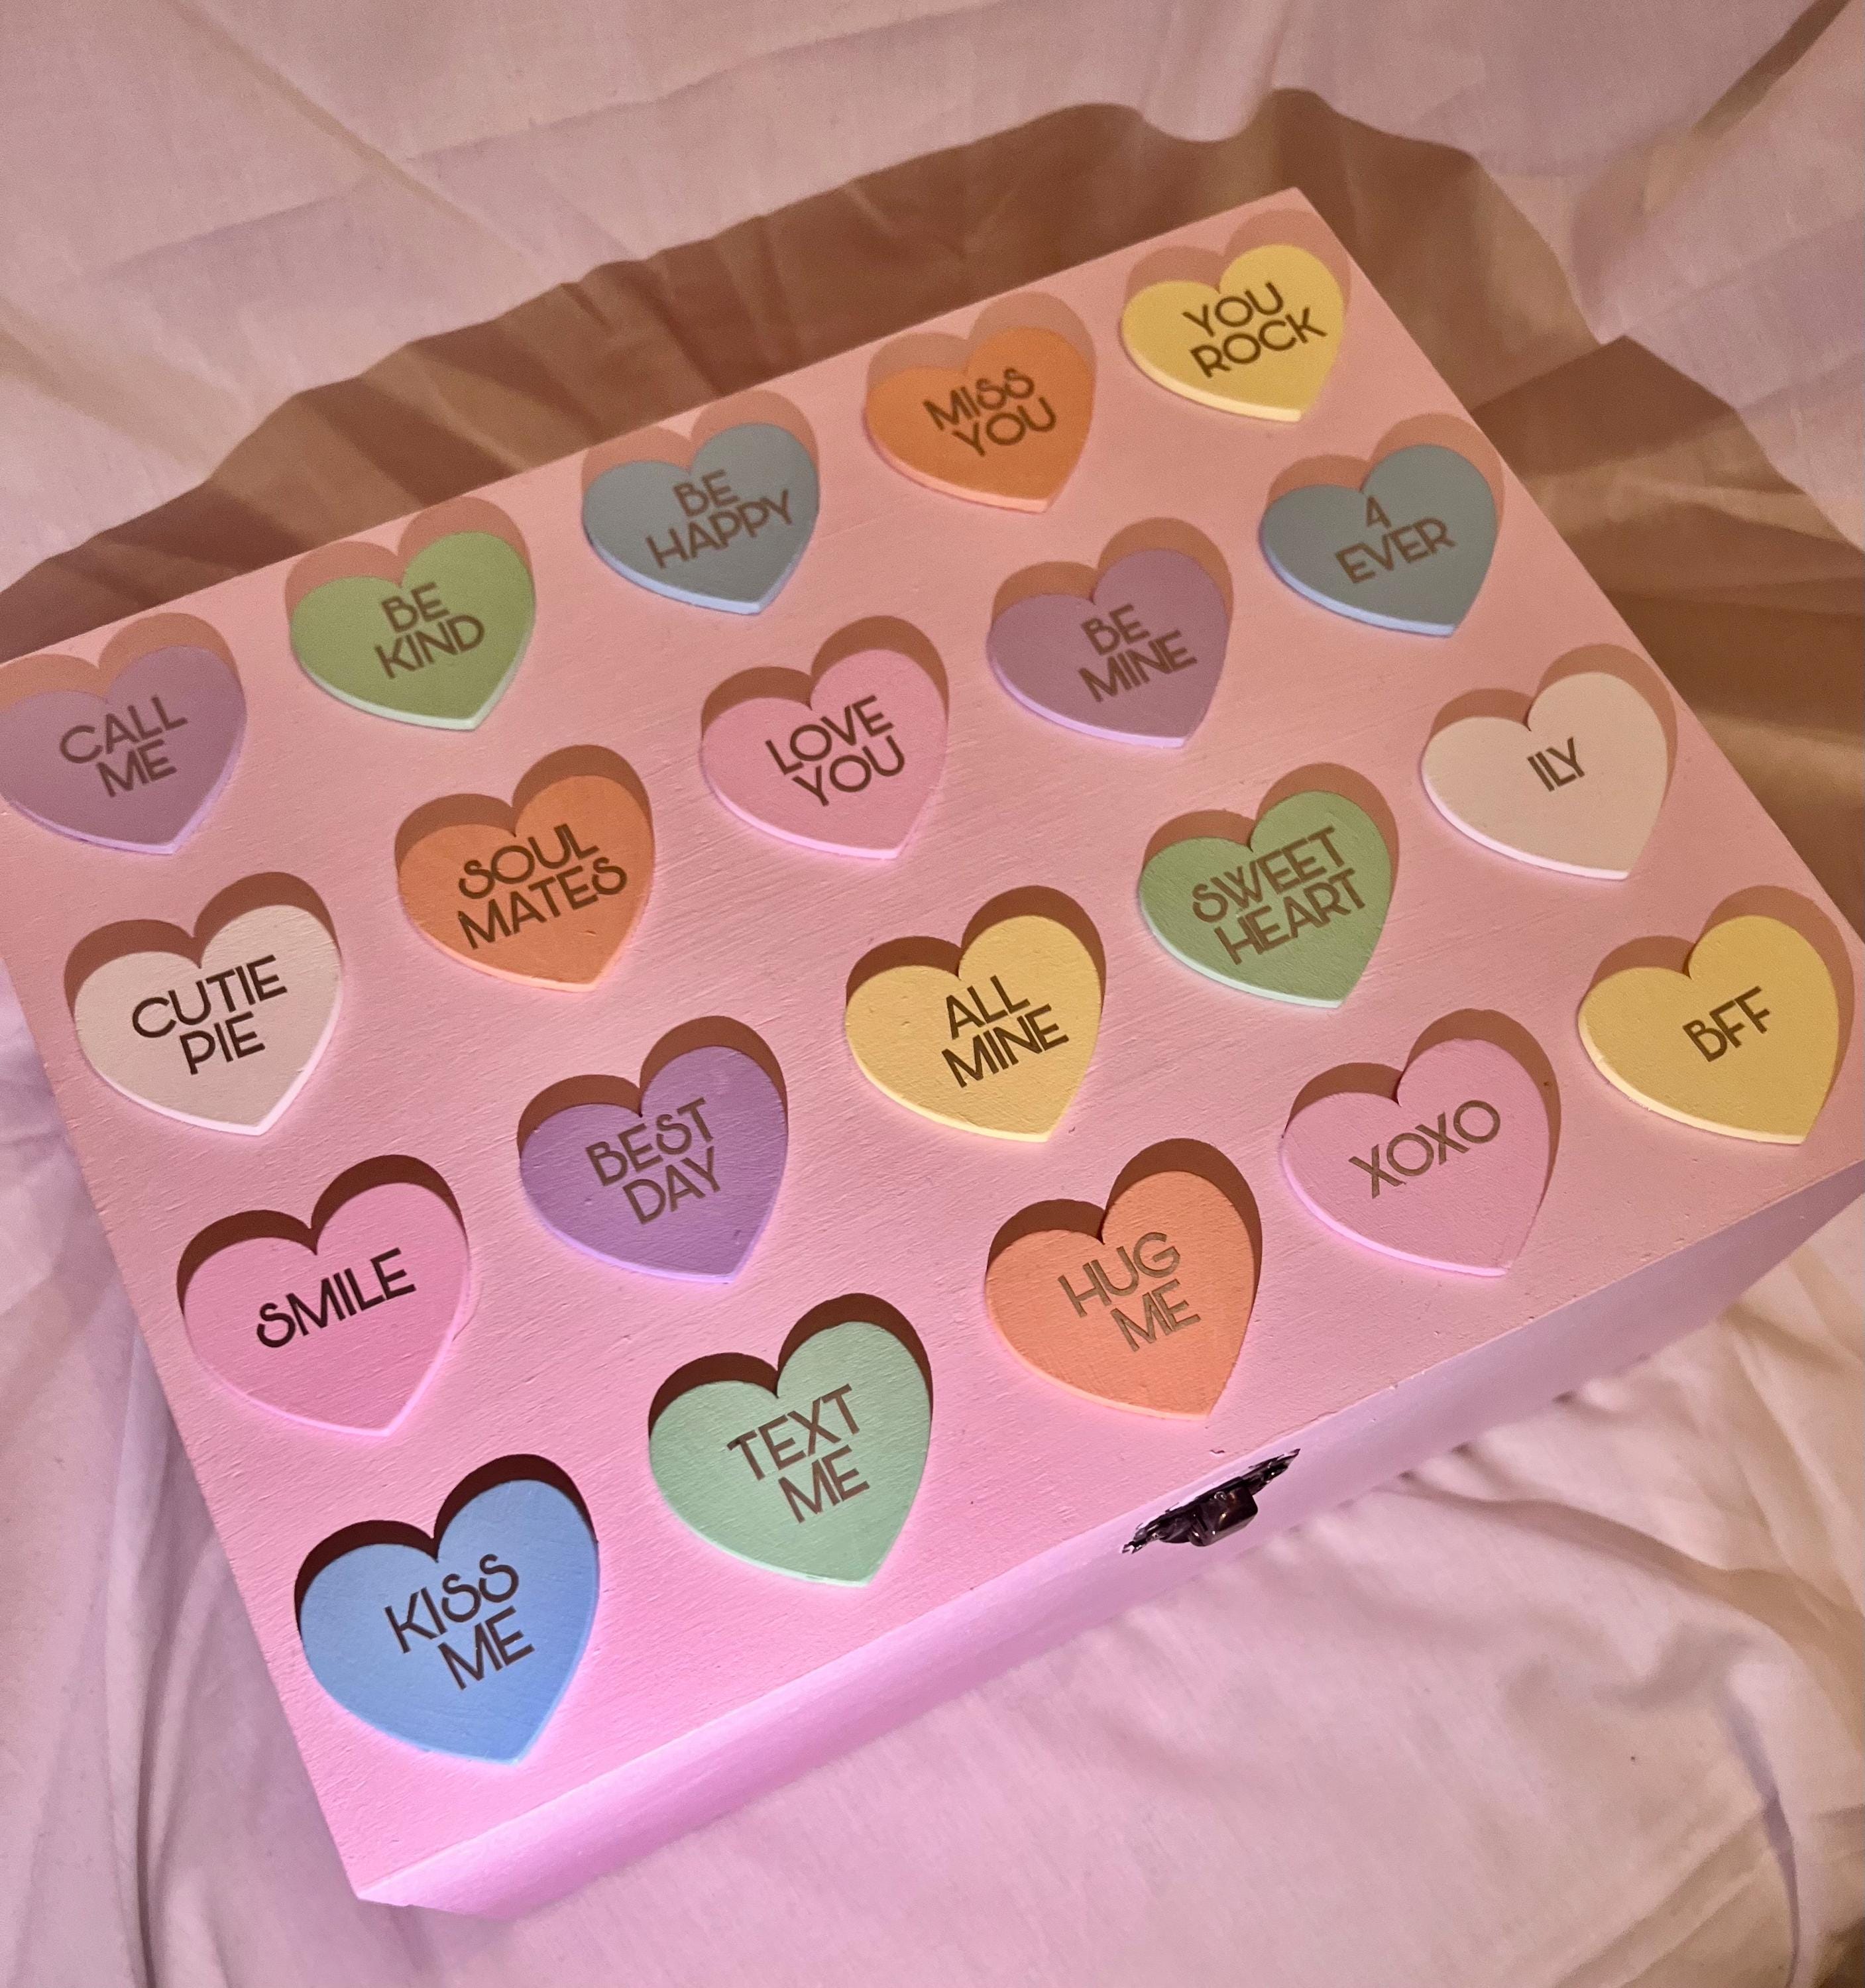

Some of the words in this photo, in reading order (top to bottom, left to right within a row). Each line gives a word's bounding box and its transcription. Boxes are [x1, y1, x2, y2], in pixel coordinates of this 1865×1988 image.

[1182, 282, 1284, 337] YOU
[1190, 307, 1327, 378] ROCK
[923, 367, 1035, 431] MISS
[952, 397, 1056, 457] YOU
[646, 489, 793, 569] HAPPY
[673, 469, 740, 517] BE
[1366, 496, 1391, 529] 4
[1335, 518, 1455, 584] EVER
[380, 582, 449, 632] BE
[1081, 604, 1150, 655] BE
[374, 614, 484, 679] KIND
[1078, 630, 1198, 702] MINE
[60, 695, 188, 763] CALL
[765, 695, 893, 775] LOVE
[1527, 736, 1585, 792] ILY
[96, 739, 177, 797] ME
[792, 735, 905, 806] YOU
[459, 824, 599, 899] SOUL
[1192, 826, 1344, 922] SWEET
[458, 857, 627, 950] MATES
[1214, 868, 1365, 965] HEART
[132, 955, 287, 1038] CUTIE
[946, 975, 1030, 1040] ALL
[1683, 986, 1771, 1062] BFF
[180, 1011, 265, 1075] PIE
[942, 1004, 1069, 1087] MINE
[585, 1097, 713, 1186] BEST
[1349, 1100, 1500, 1199] XOXO
[622, 1146, 722, 1225] DAY
[256, 1248, 416, 1348] SMILE
[1058, 1232, 1180, 1317] HUG
[1110, 1278, 1201, 1352] ME
[726, 1384, 860, 1480] TEXT
[778, 1445, 870, 1523] ME
[385, 1554, 518, 1653] KISS
[438, 1606, 534, 1690] ME
